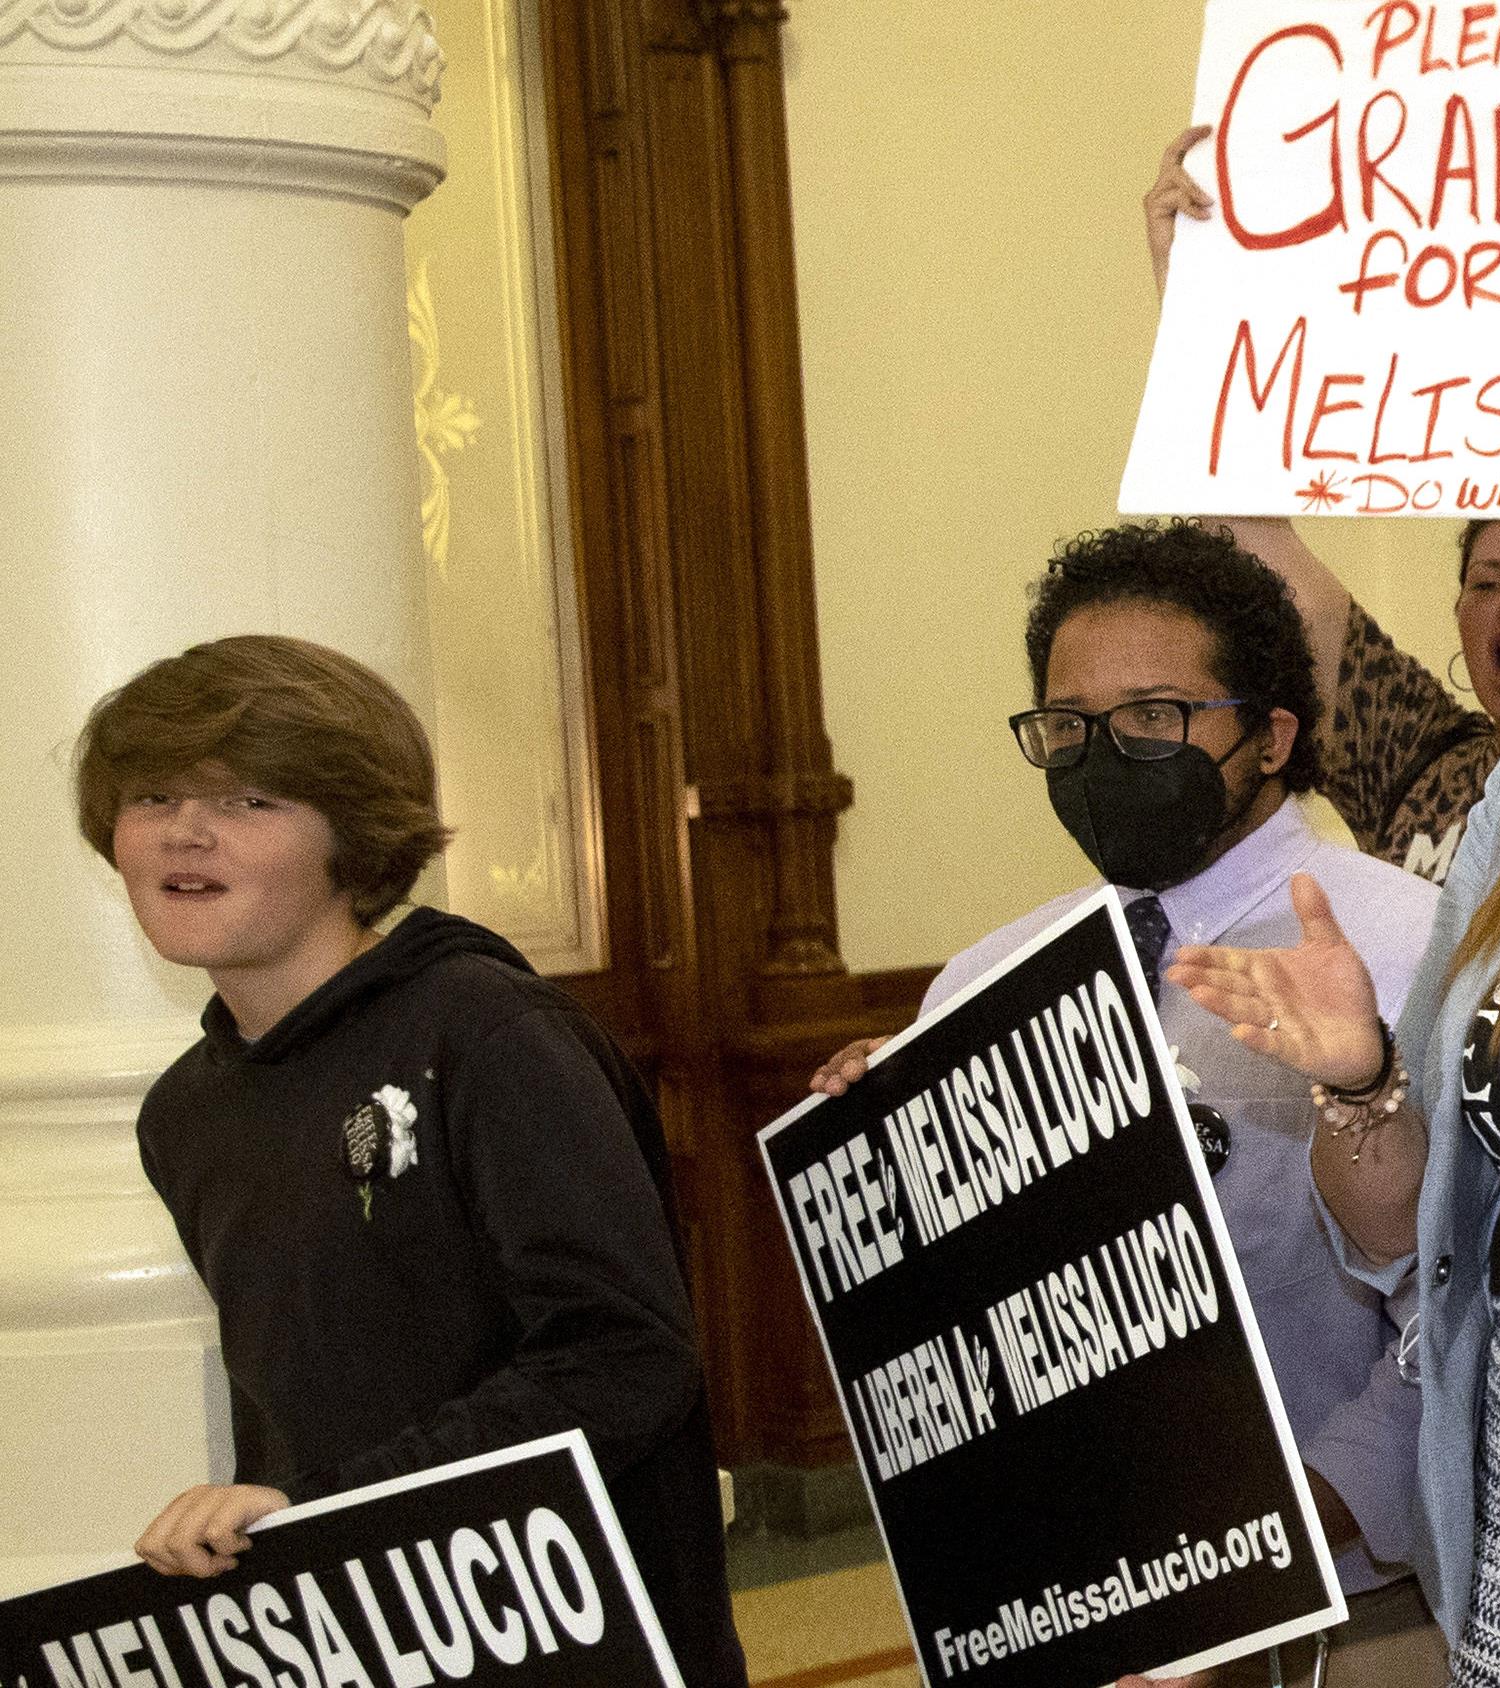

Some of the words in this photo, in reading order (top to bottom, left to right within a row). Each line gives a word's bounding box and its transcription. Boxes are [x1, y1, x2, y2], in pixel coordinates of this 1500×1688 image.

[788, 1133, 904, 1302] FREE
[884, 1043, 1047, 1246] MELISSA
[1010, 969, 1151, 1169] LUCIO
[852, 1335, 973, 1482] LIBEREN
[952, 1325, 997, 1436] A
[986, 1254, 1130, 1416] MELISSA
[1099, 1202, 1220, 1359] LUCIO
[345, 1507, 605, 1687] LUCIO
[934, 1511, 1293, 1678] FreeMelissaLucio.org
